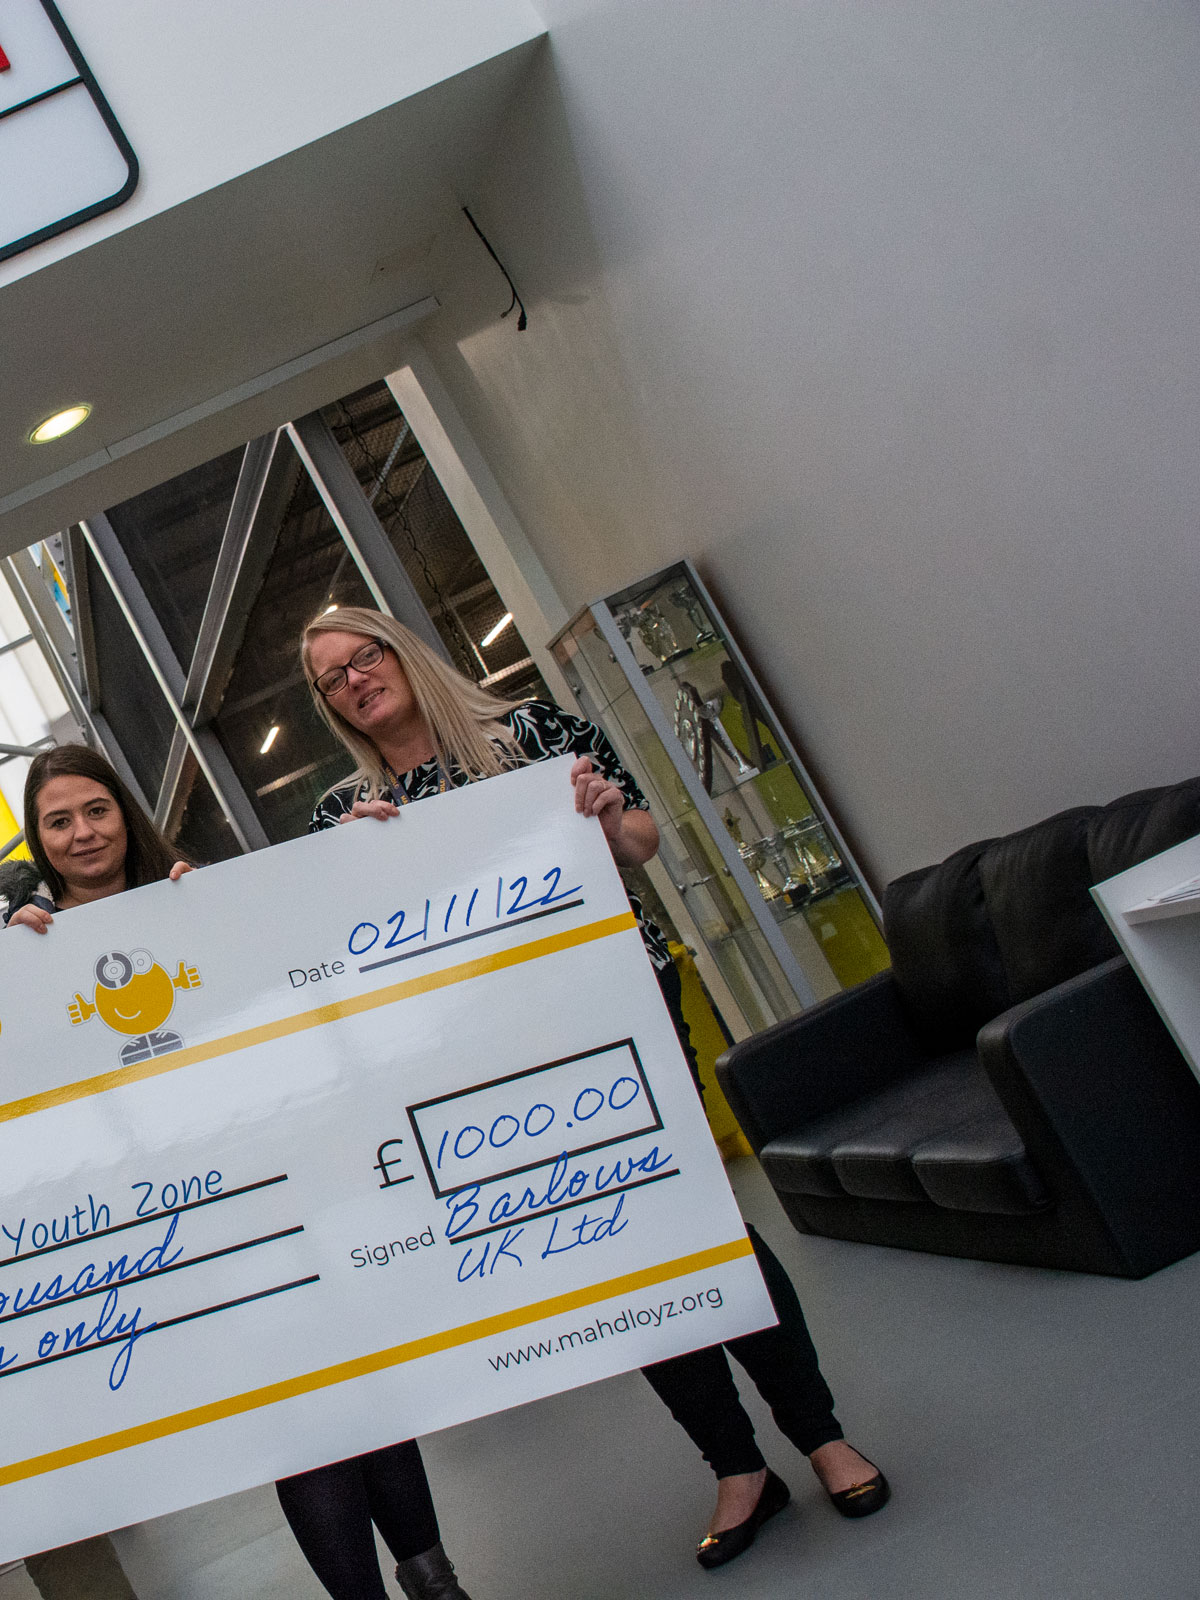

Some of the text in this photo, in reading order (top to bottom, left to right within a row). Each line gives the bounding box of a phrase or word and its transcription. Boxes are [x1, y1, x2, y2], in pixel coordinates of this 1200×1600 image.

[287, 957, 346, 990] Date
[373, 1138, 415, 1190] £
[436, 1076, 640, 1169] 1000.00
[1, 1194, 111, 1257] Youth
[131, 1169, 224, 1218] Zone
[445, 1151, 674, 1238] Barlows
[457, 1193, 629, 1283] UK Ltd
[350, 1226, 436, 1271] Signed
[38, 1287, 157, 1391] only
[487, 1284, 725, 1373] www.mahdloyz.org
